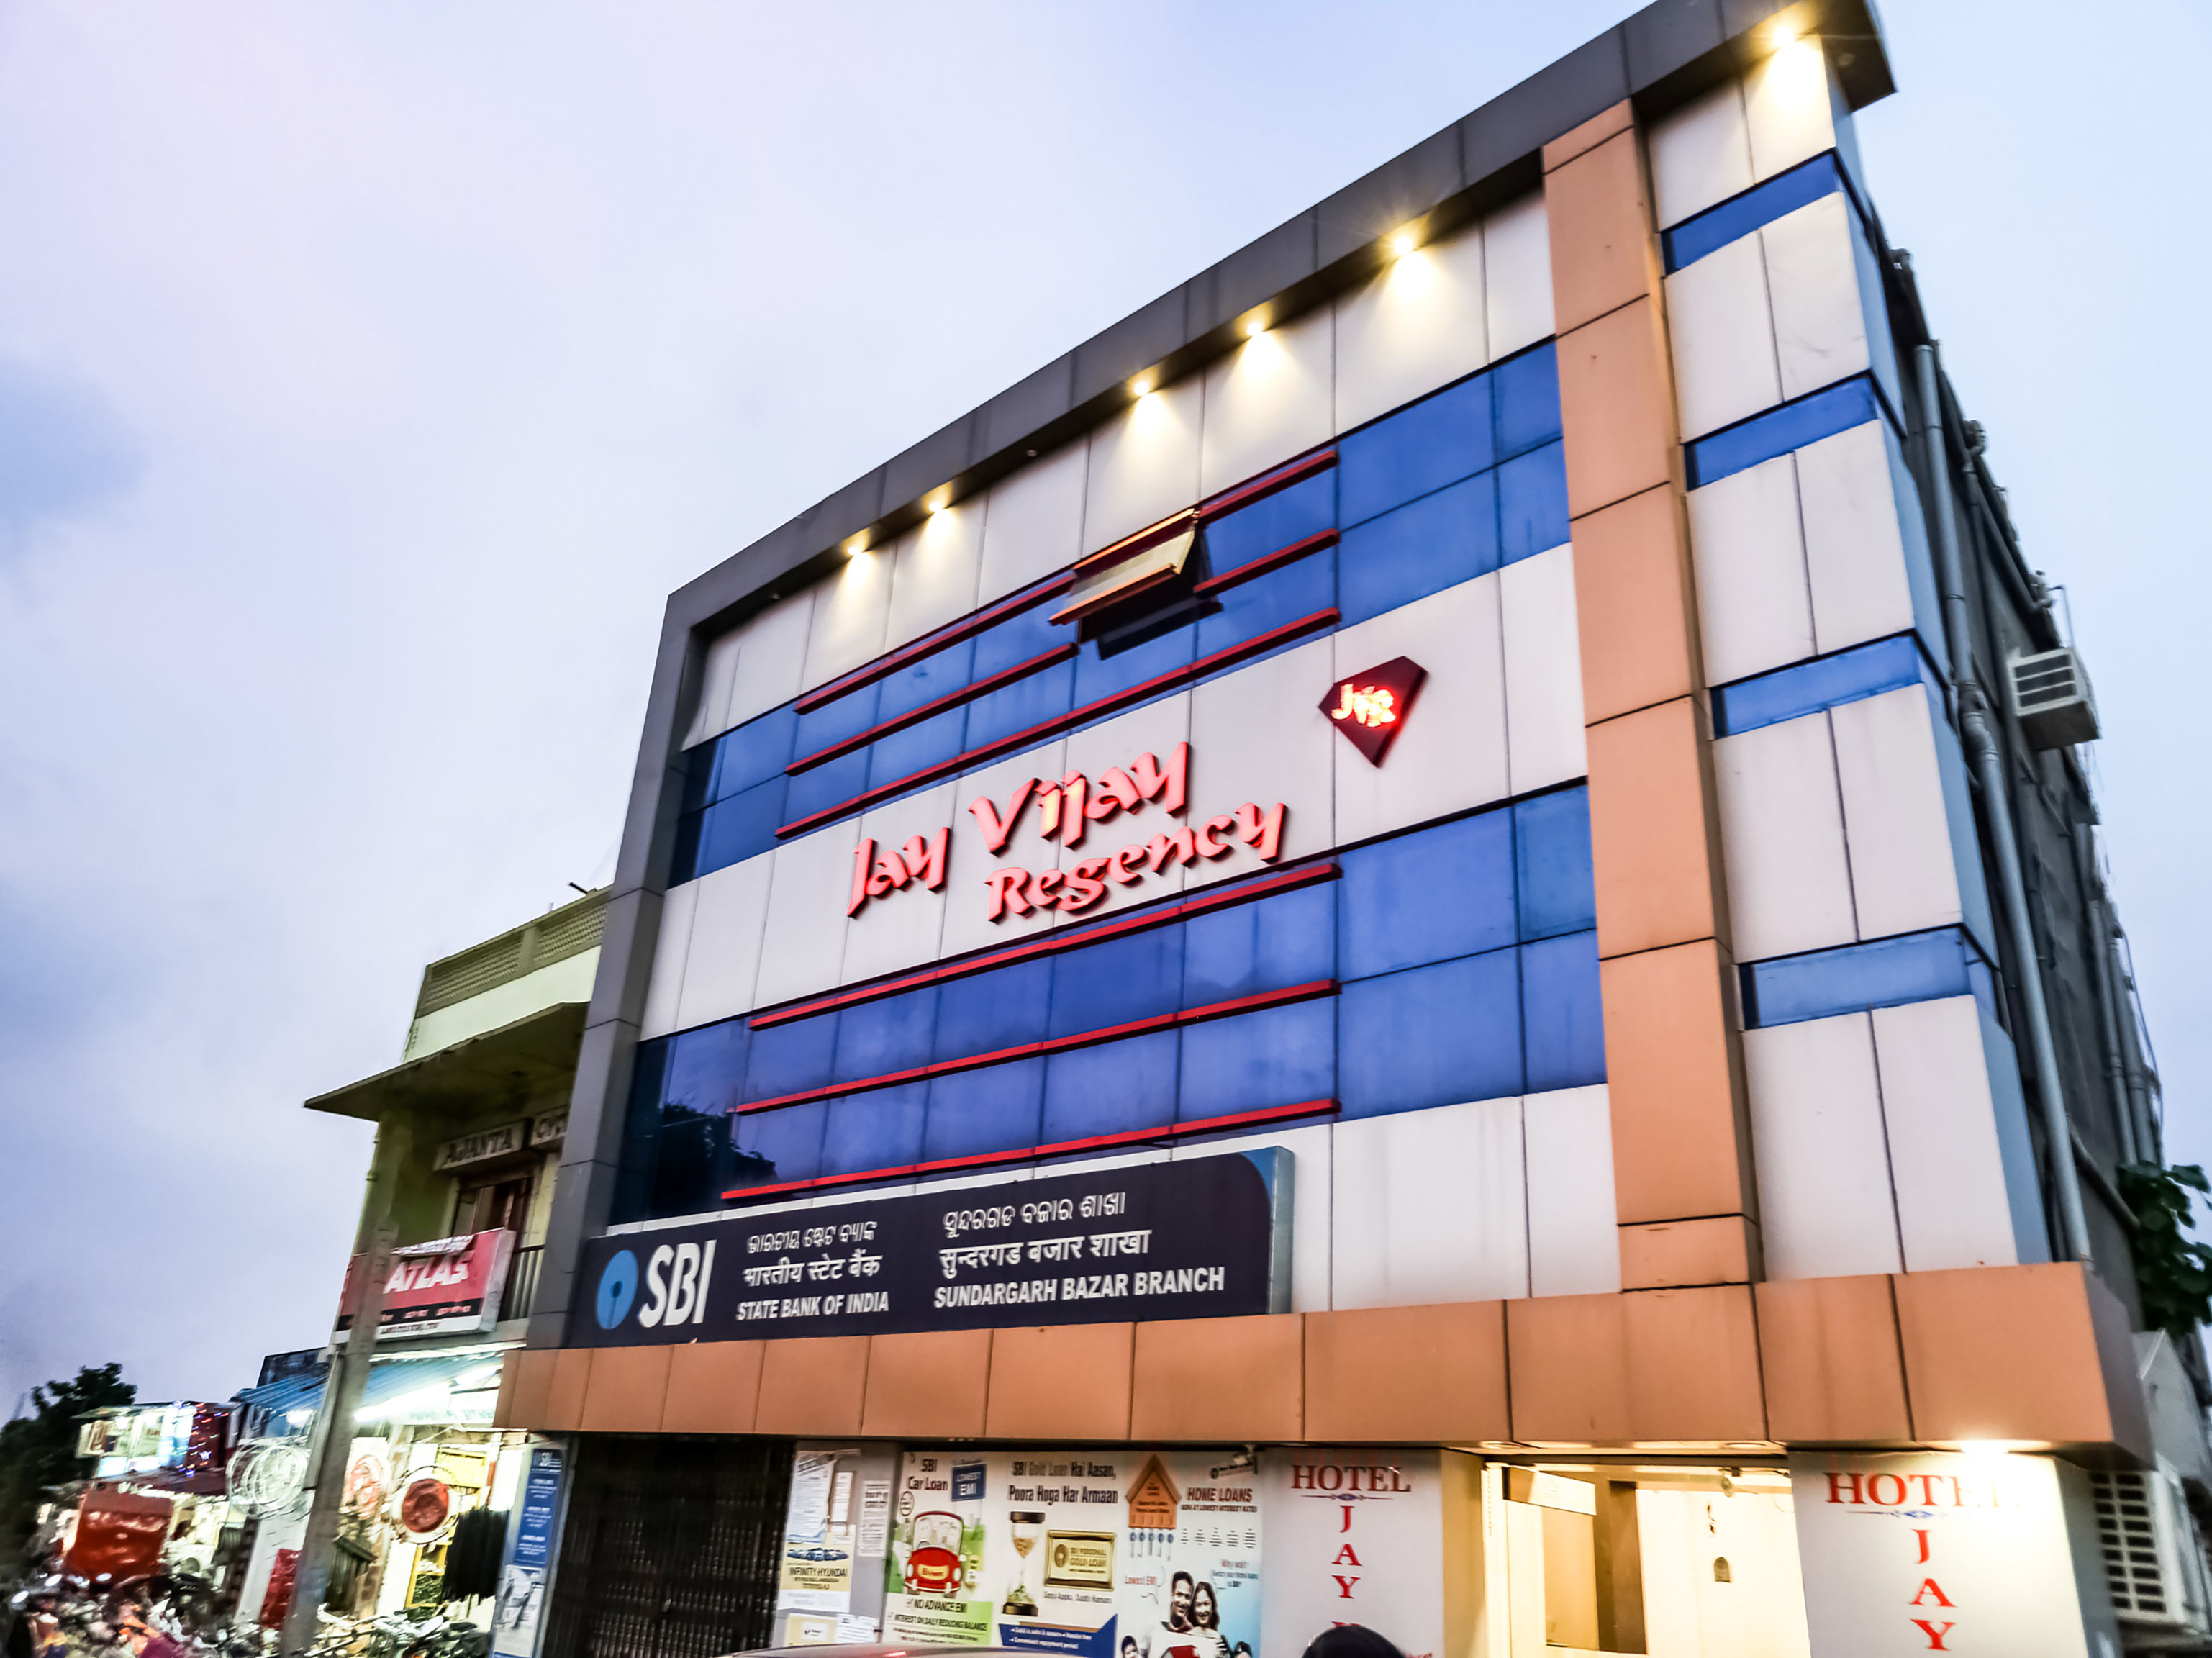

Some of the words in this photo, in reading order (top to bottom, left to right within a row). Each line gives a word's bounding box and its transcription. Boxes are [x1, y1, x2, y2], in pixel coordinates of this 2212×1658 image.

[846, 827, 951, 918] Jay
[969, 741, 1189, 857] Vijay
[985, 802, 1287, 924] Regency
[1027, 1236, 1085, 1263] बजार
[1088, 1229, 1152, 1257] शाखा
[382, 1251, 475, 1294] ATLAS
[743, 1256, 805, 1287] भारतीय
[807, 1253, 846, 1281] स्टेट
[848, 1248, 883, 1277] बैंक
[638, 1239, 717, 1328] SBI
[933, 1279, 1058, 1308] SUNDARGARH
[1061, 1273, 1128, 1300] BAZAR
[1133, 1267, 1225, 1296] BRANCH
[735, 1300, 780, 1320] STATE
[779, 1296, 822, 1318] BANK
[822, 1295, 845, 1315] OF
[845, 1291, 889, 1314] INDIA
[921, 1459, 938, 1472] SBI
[1012, 1461, 1027, 1476] SBI
[1071, 1462, 1085, 1477] Hai
[1291, 1464, 1412, 1492] HOTEL
[908, 1476, 923, 1490] Car
[925, 1477, 948, 1490] Loan
[959, 1483, 976, 1495] EMI
[1009, 1485, 1033, 1501] Poora
[1036, 1485, 1059, 1505] Hoga
[1063, 1485, 1079, 1503] Har
[1082, 1486, 1118, 1503] Armaan
[1187, 1487, 1216, 1501] HOME
[1218, 1487, 1253, 1503] LOANS
[1331, 1505, 1363, 1599] JAY
[915, 1599, 923, 1609] NO
[925, 1600, 954, 1612] ADVANCE
[1908, 1528, 1958, 1652] JAY
